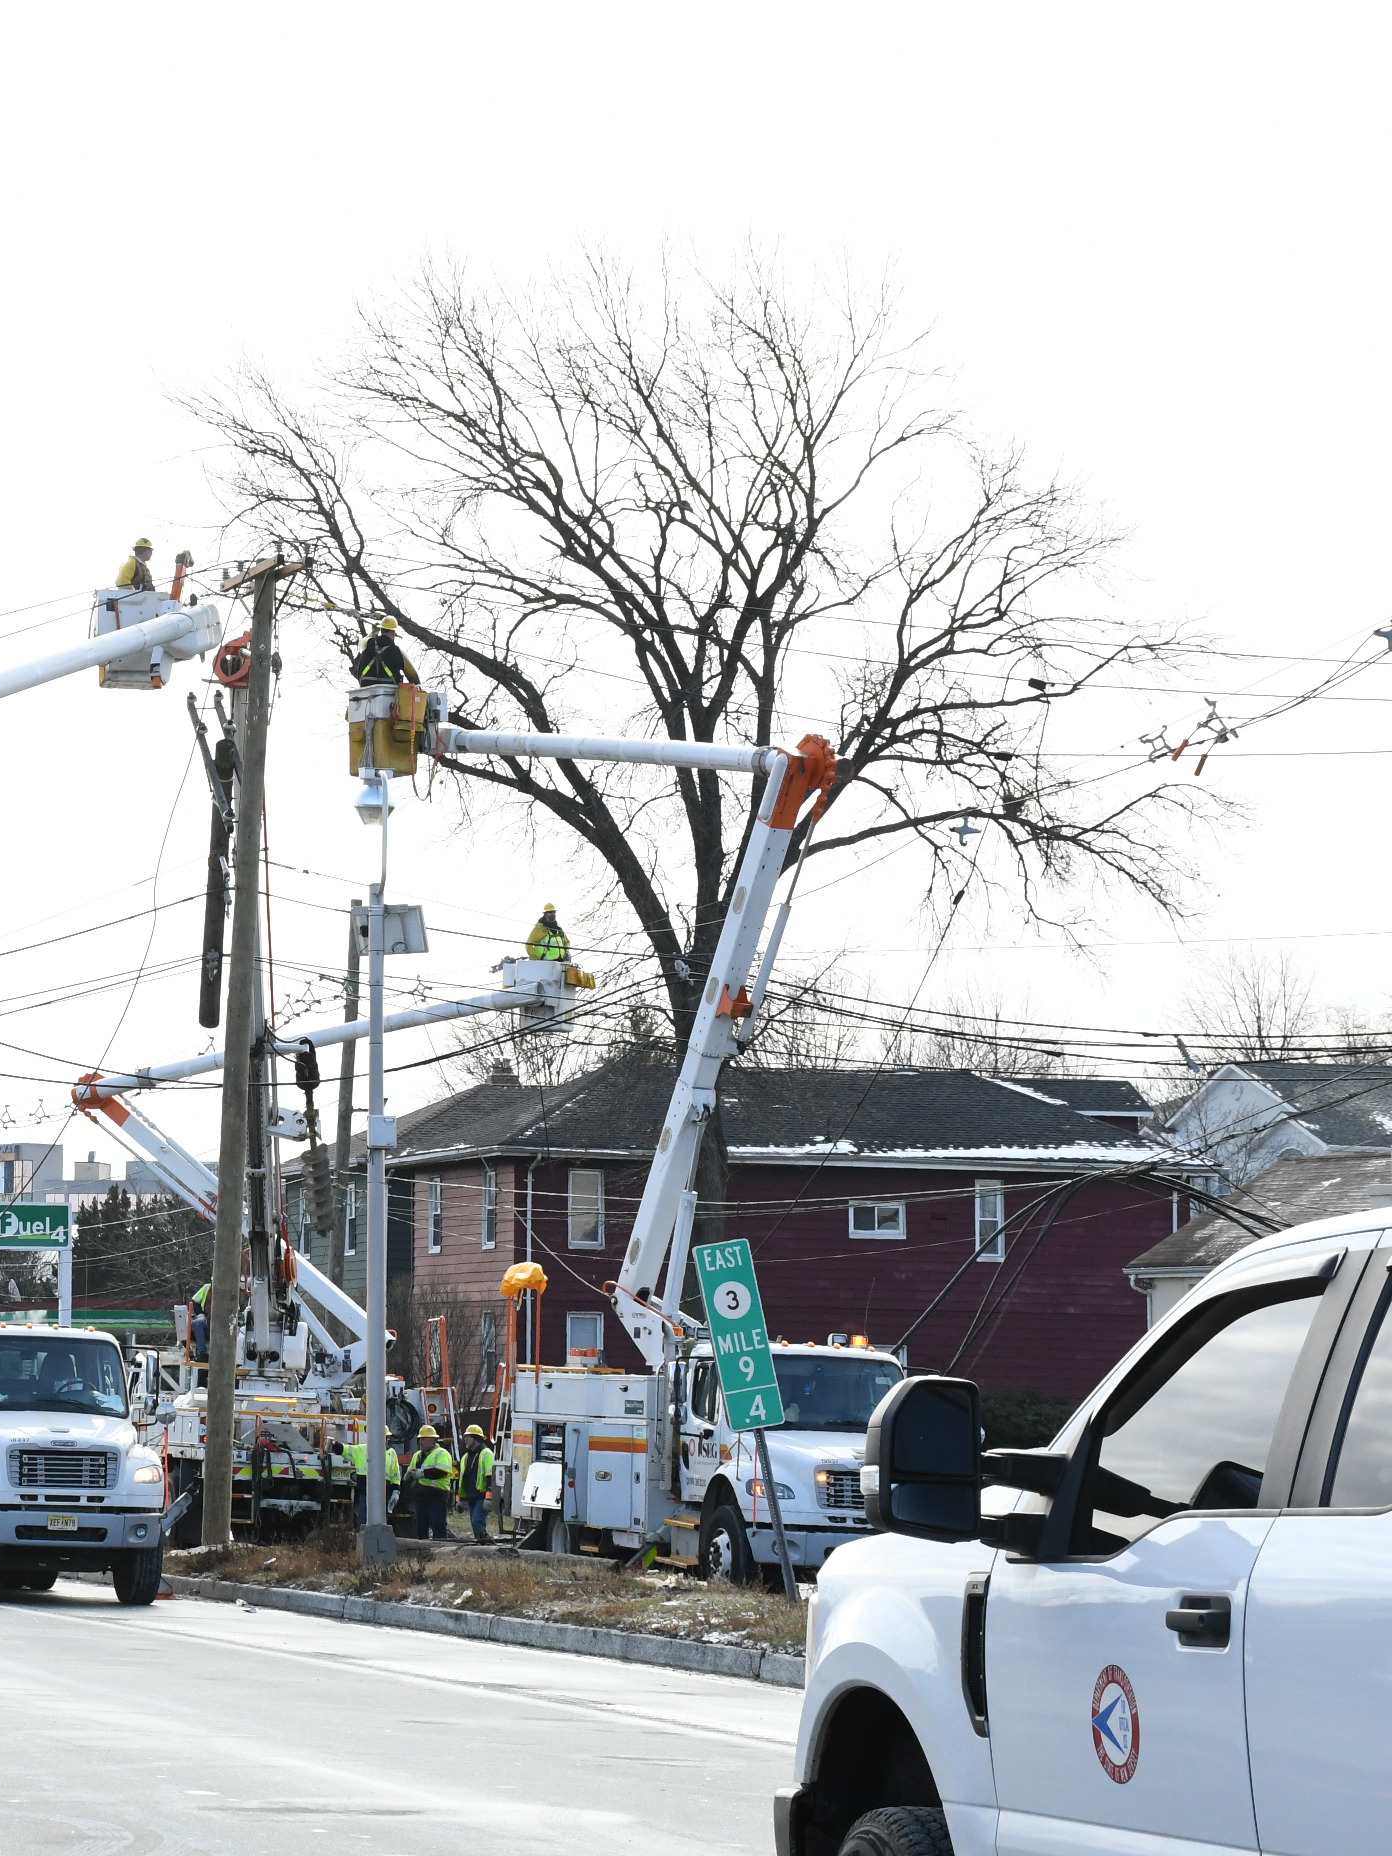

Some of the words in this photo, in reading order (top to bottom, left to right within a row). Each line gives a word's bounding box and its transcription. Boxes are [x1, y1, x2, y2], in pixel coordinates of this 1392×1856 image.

[703, 1246, 743, 1271] EAST
[725, 1290, 740, 1311] 3
[717, 1328, 765, 1356] MILE
[738, 1356, 755, 1382] 9
